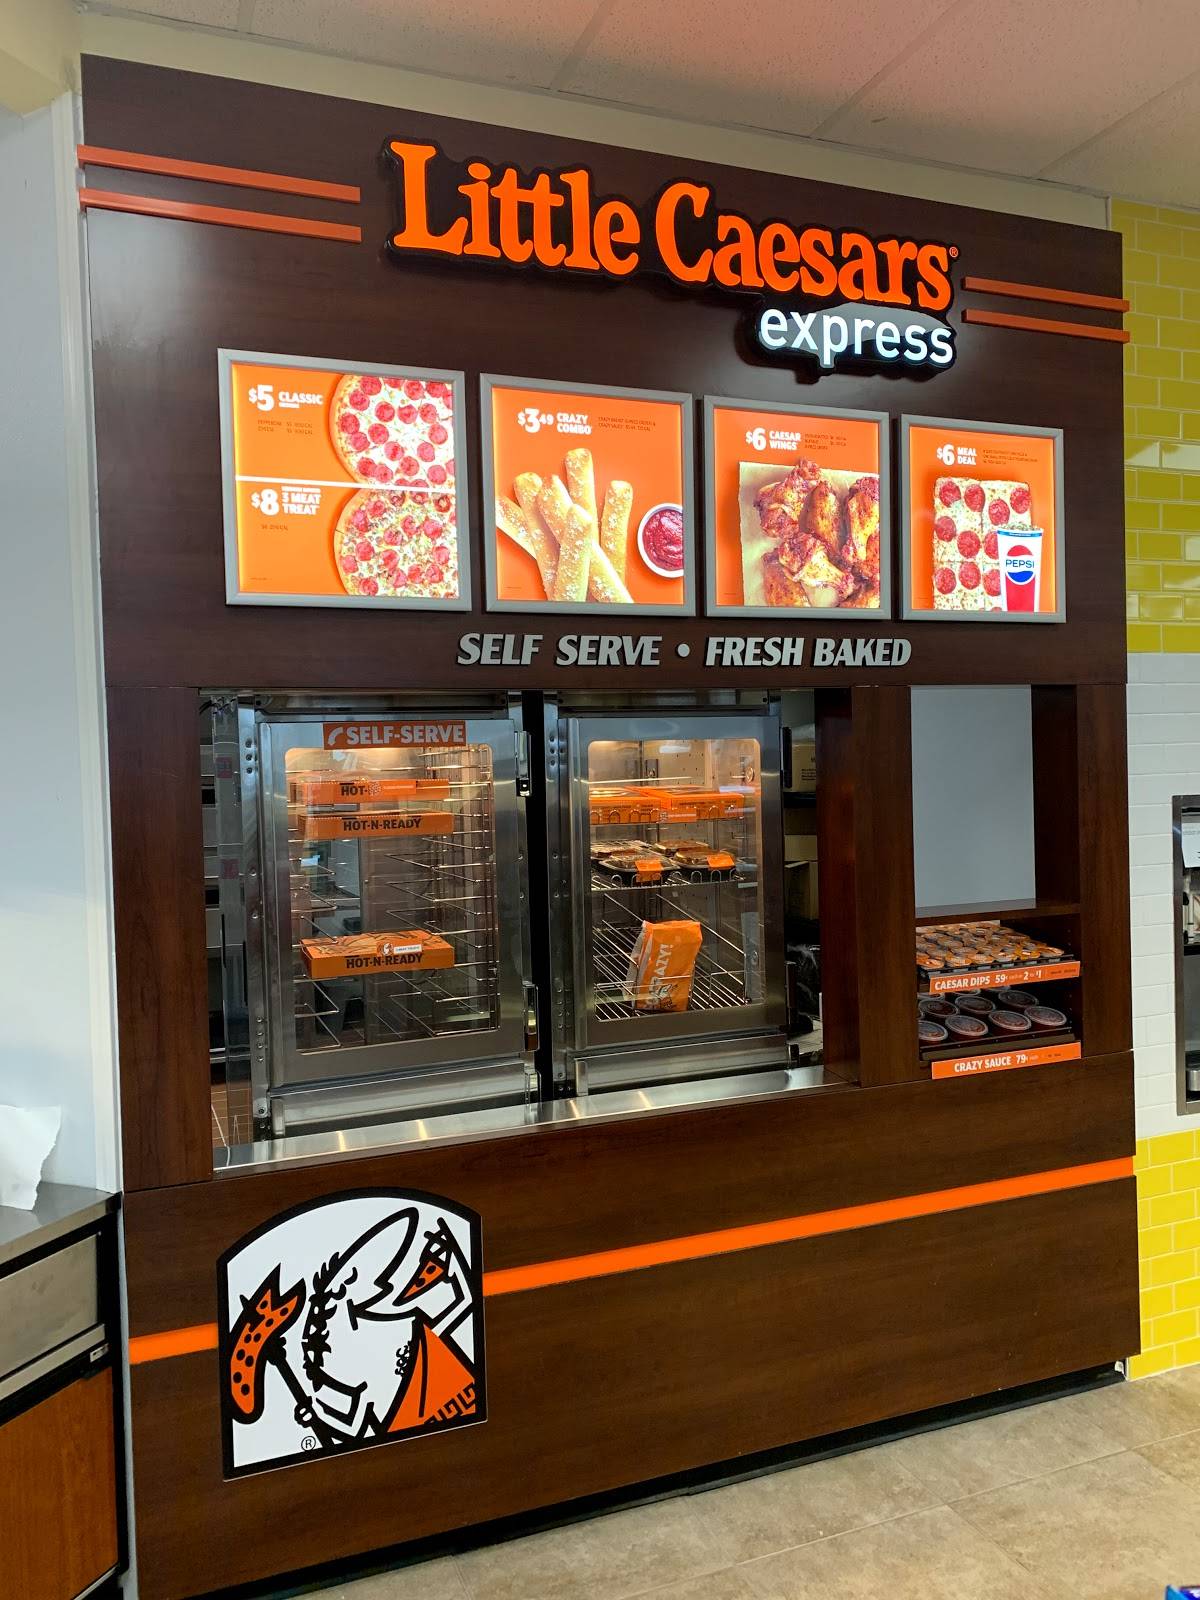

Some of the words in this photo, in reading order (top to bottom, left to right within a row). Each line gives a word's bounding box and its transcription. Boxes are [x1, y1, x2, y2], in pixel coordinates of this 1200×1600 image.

[390, 141, 641, 275] Little
[759, 308, 954, 365] express
[248, 384, 275, 412] $5
[278, 391, 324, 406] CLASSIC
[556, 412, 589, 424] CRAZY
[556, 424, 592, 435] COMBO
[769, 430, 801, 442] CAESAR
[745, 427, 767, 451] $6
[769, 441, 798, 451] WINGS
[936, 444, 956, 466] $6
[957, 447, 977, 457] MEAL
[957, 456, 977, 466] DEAL
[251, 488, 280, 516] $8
[290, 492, 322, 505] MEAT
[281, 503, 320, 515] TREAT
[1005, 559, 1035, 569] PEPSI
[457, 632, 544, 666] SELF
[556, 634, 663, 666] SERVE
[705, 636, 804, 667] FRESH
[813, 637, 912, 667] BAKED
[346, 724, 464, 746] SELF-SERVE
[343, 818, 422, 832] HOT-N-READY
[346, 953, 424, 969] HOT-N-READY
[934, 978, 969, 991] CAESAR
[969, 977, 991, 989] DIPS
[954, 1060, 983, 1073] CRAZY
[984, 1057, 1012, 1068] SAUCE
